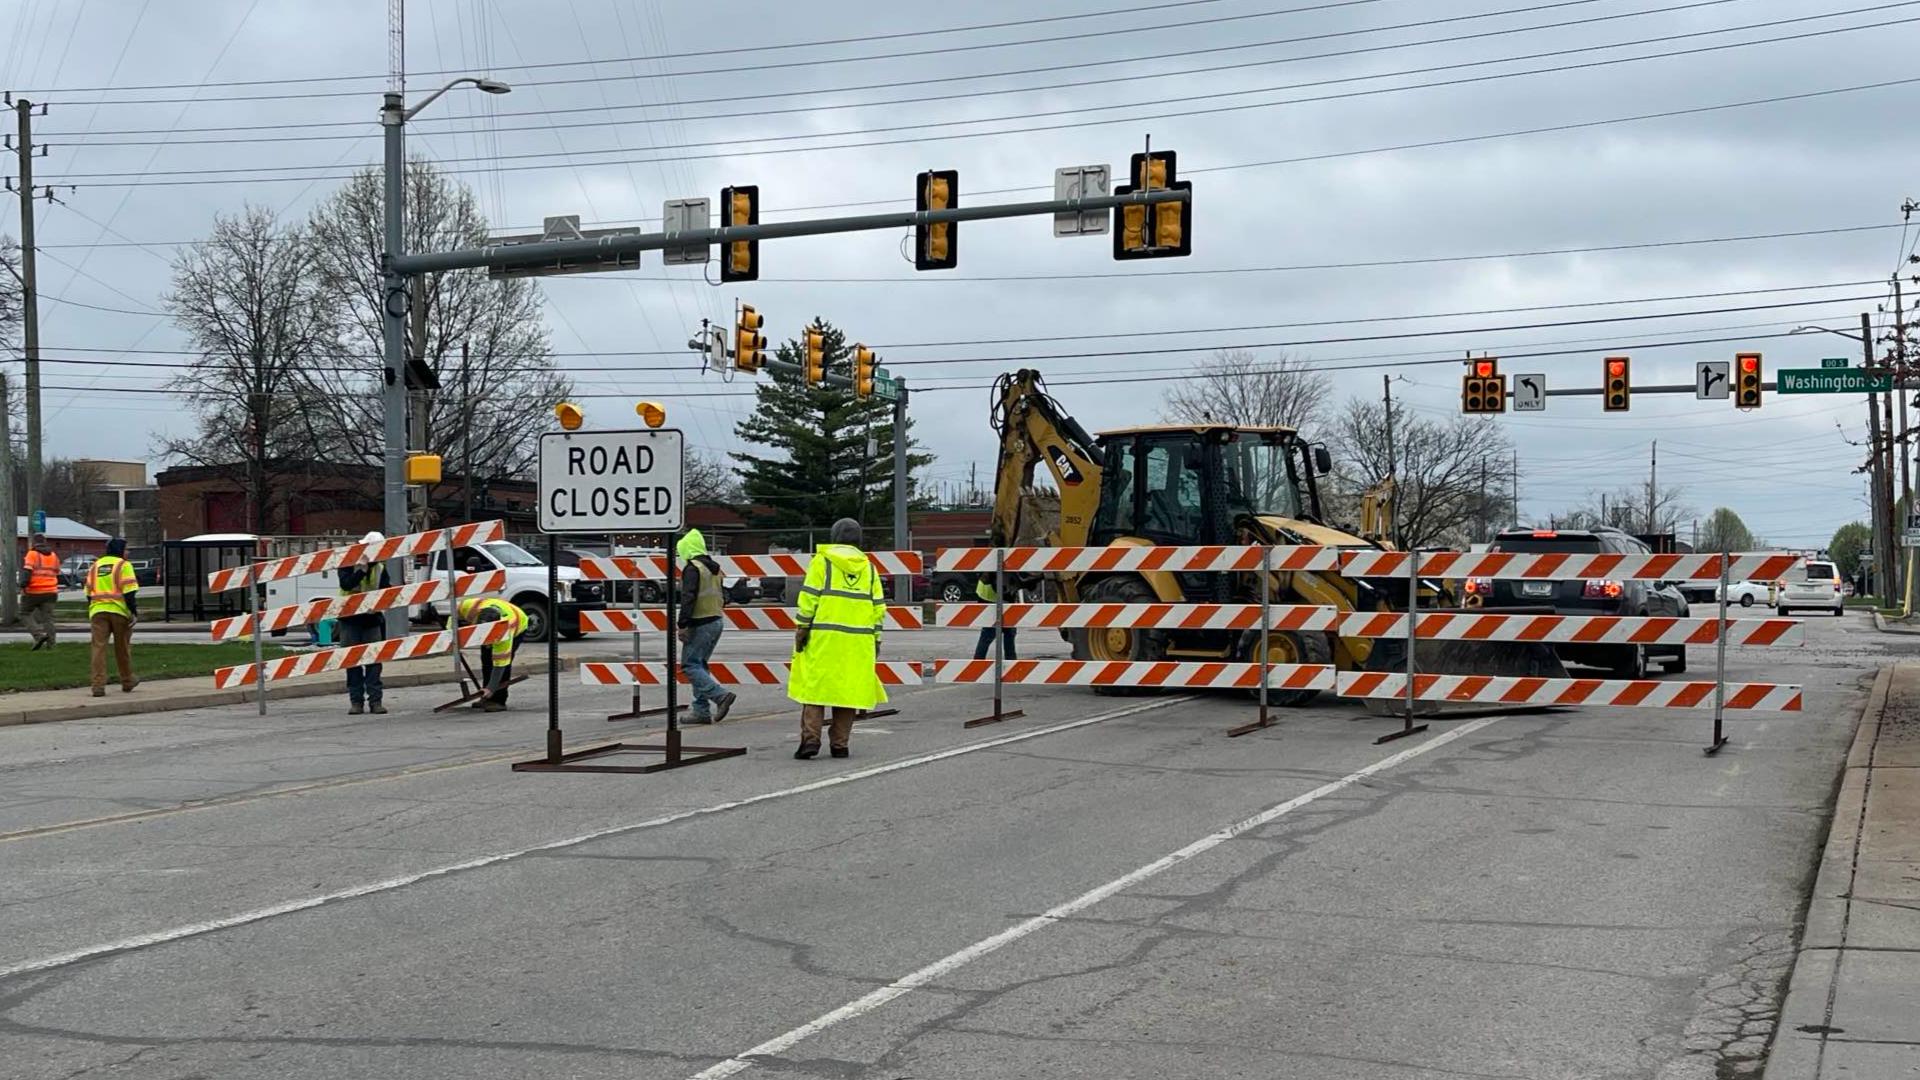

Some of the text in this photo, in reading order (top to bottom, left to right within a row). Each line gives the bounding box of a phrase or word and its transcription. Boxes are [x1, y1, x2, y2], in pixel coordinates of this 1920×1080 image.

[1784, 374, 1865, 392] Washington
[1518, 399, 1541, 409] ONLY
[569, 445, 654, 475] ROAD
[1056, 454, 1074, 479] CAT
[550, 486, 672, 517] CLOSED
